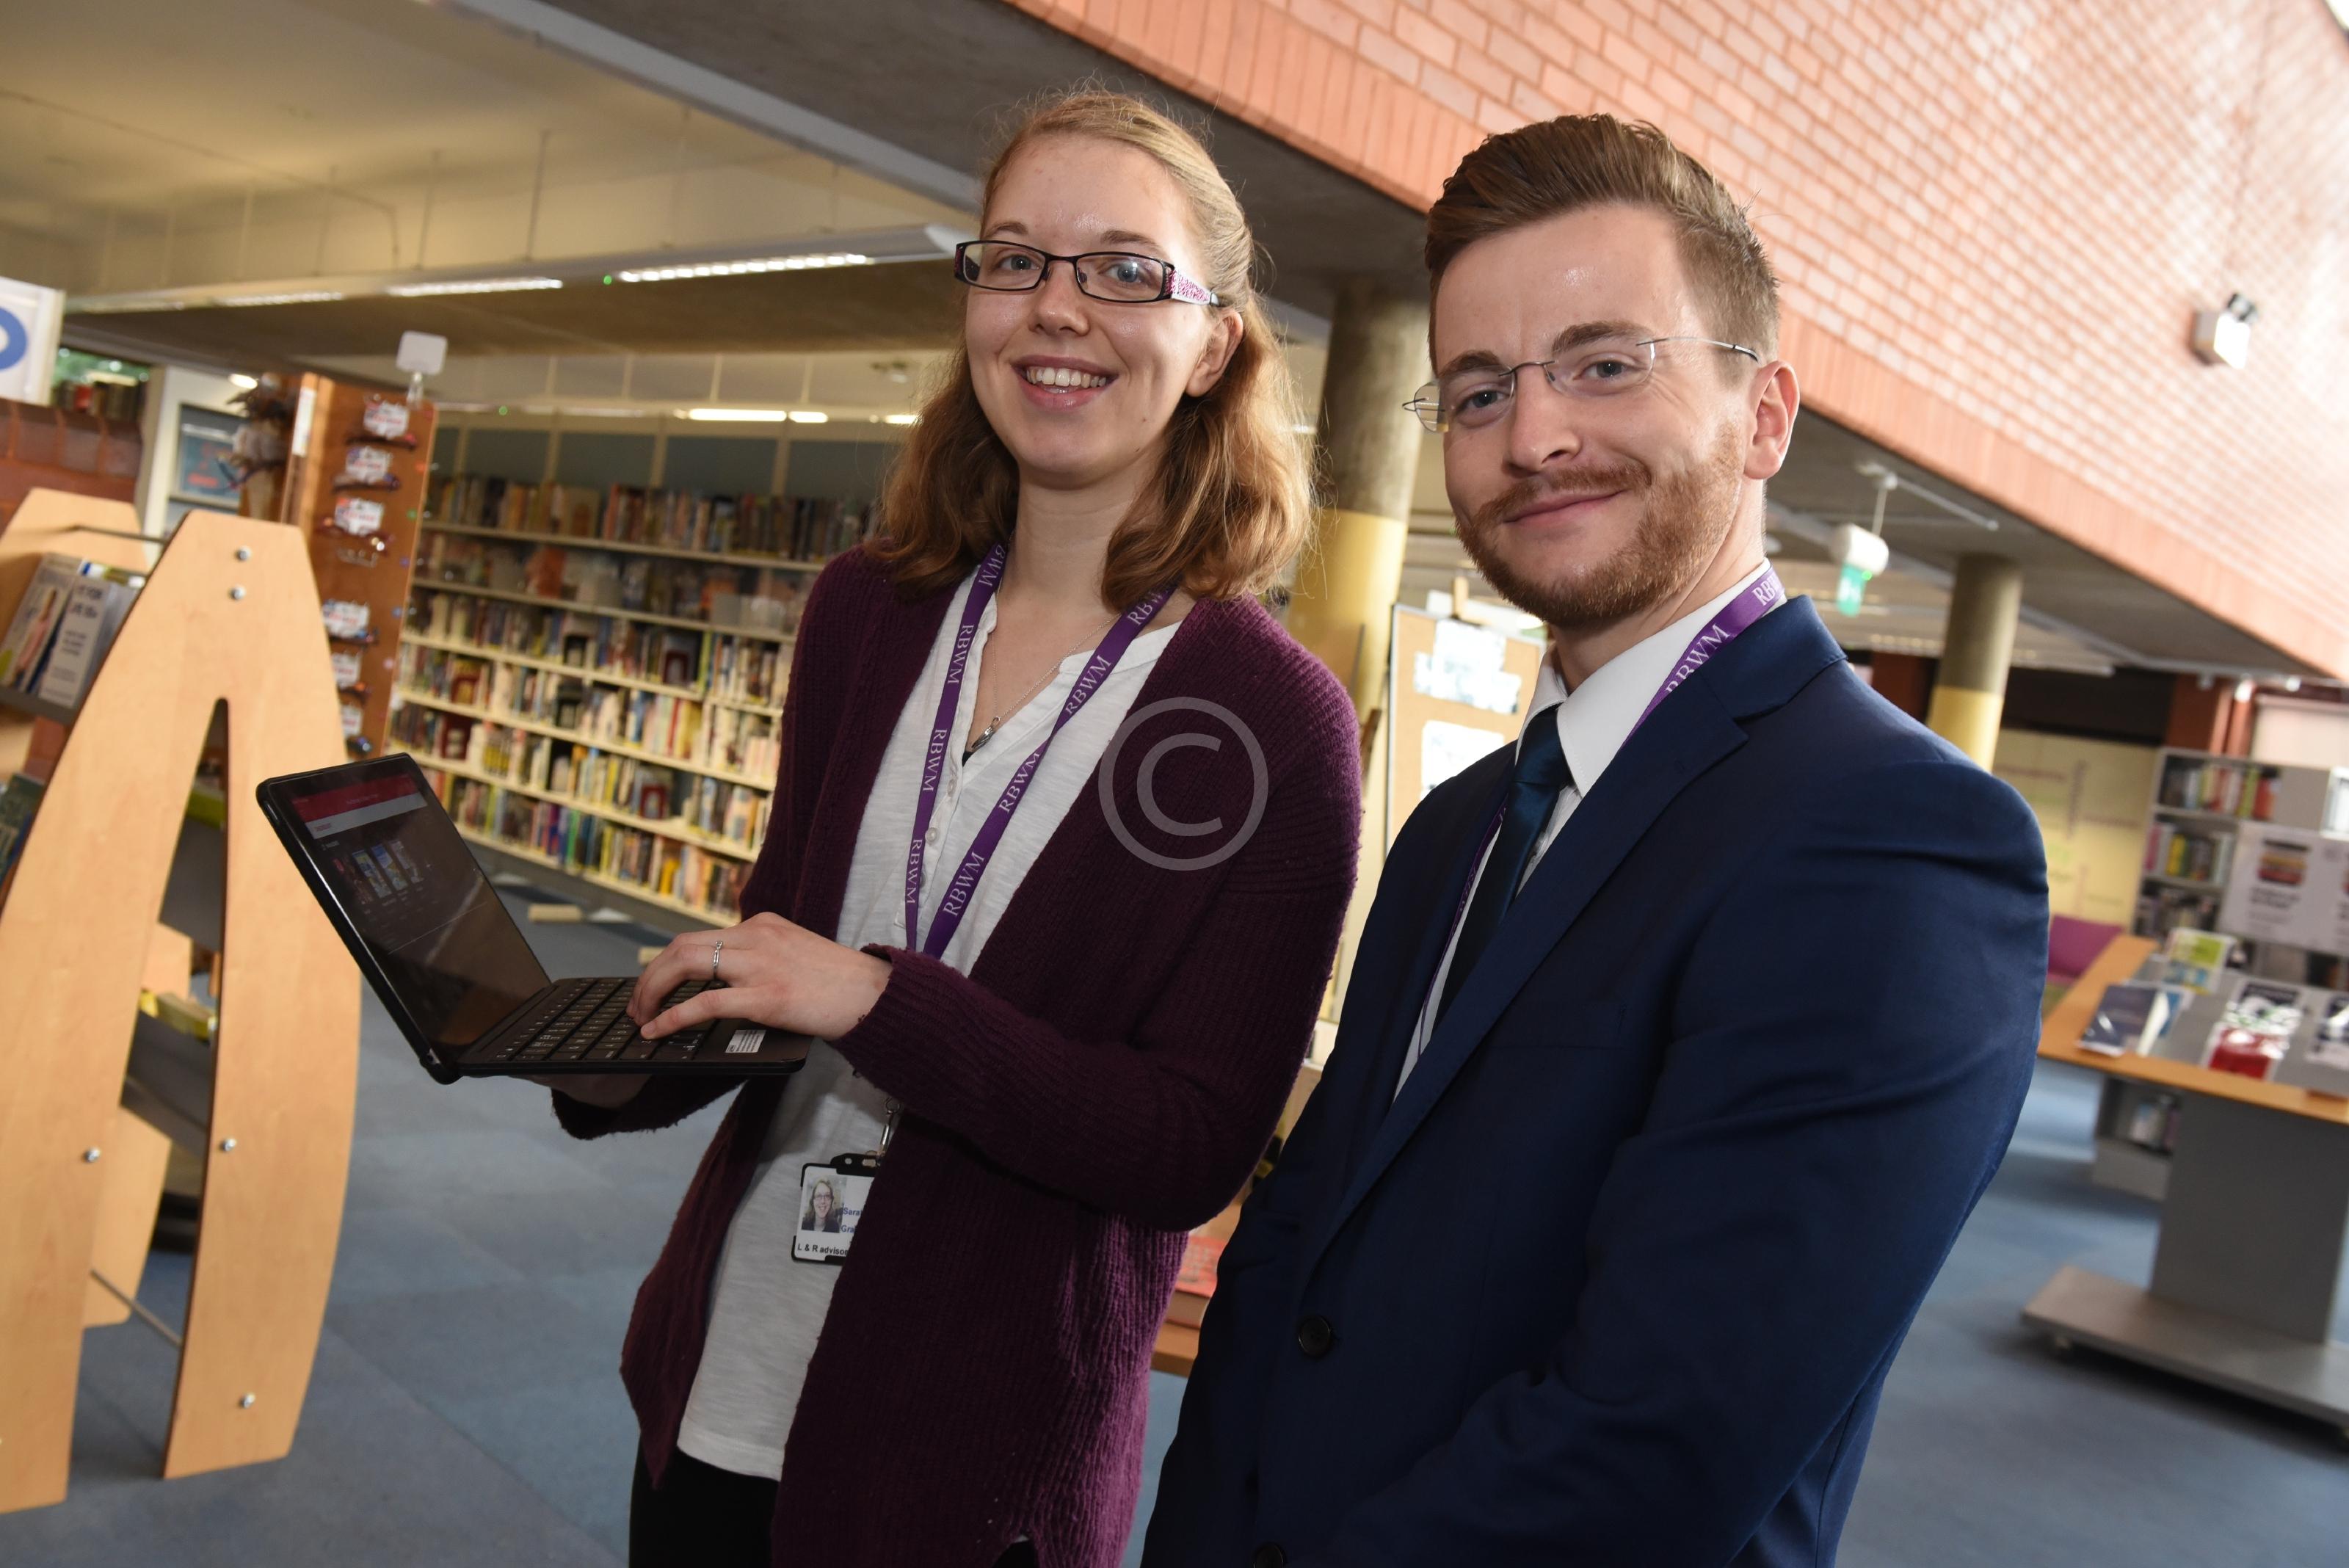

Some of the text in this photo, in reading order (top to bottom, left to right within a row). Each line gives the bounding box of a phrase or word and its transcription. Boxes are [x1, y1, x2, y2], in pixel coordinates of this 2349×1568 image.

[907, 545, 1006, 904] BWM RBWM RBWM RBWM
[942, 851, 985, 917] RBWM
[998, 752, 1040, 813] RBWM
[1064, 655, 1112, 715] RBWM
[841, 1224, 855, 1233] Gra
[843, 1207, 863, 1216] Sara
